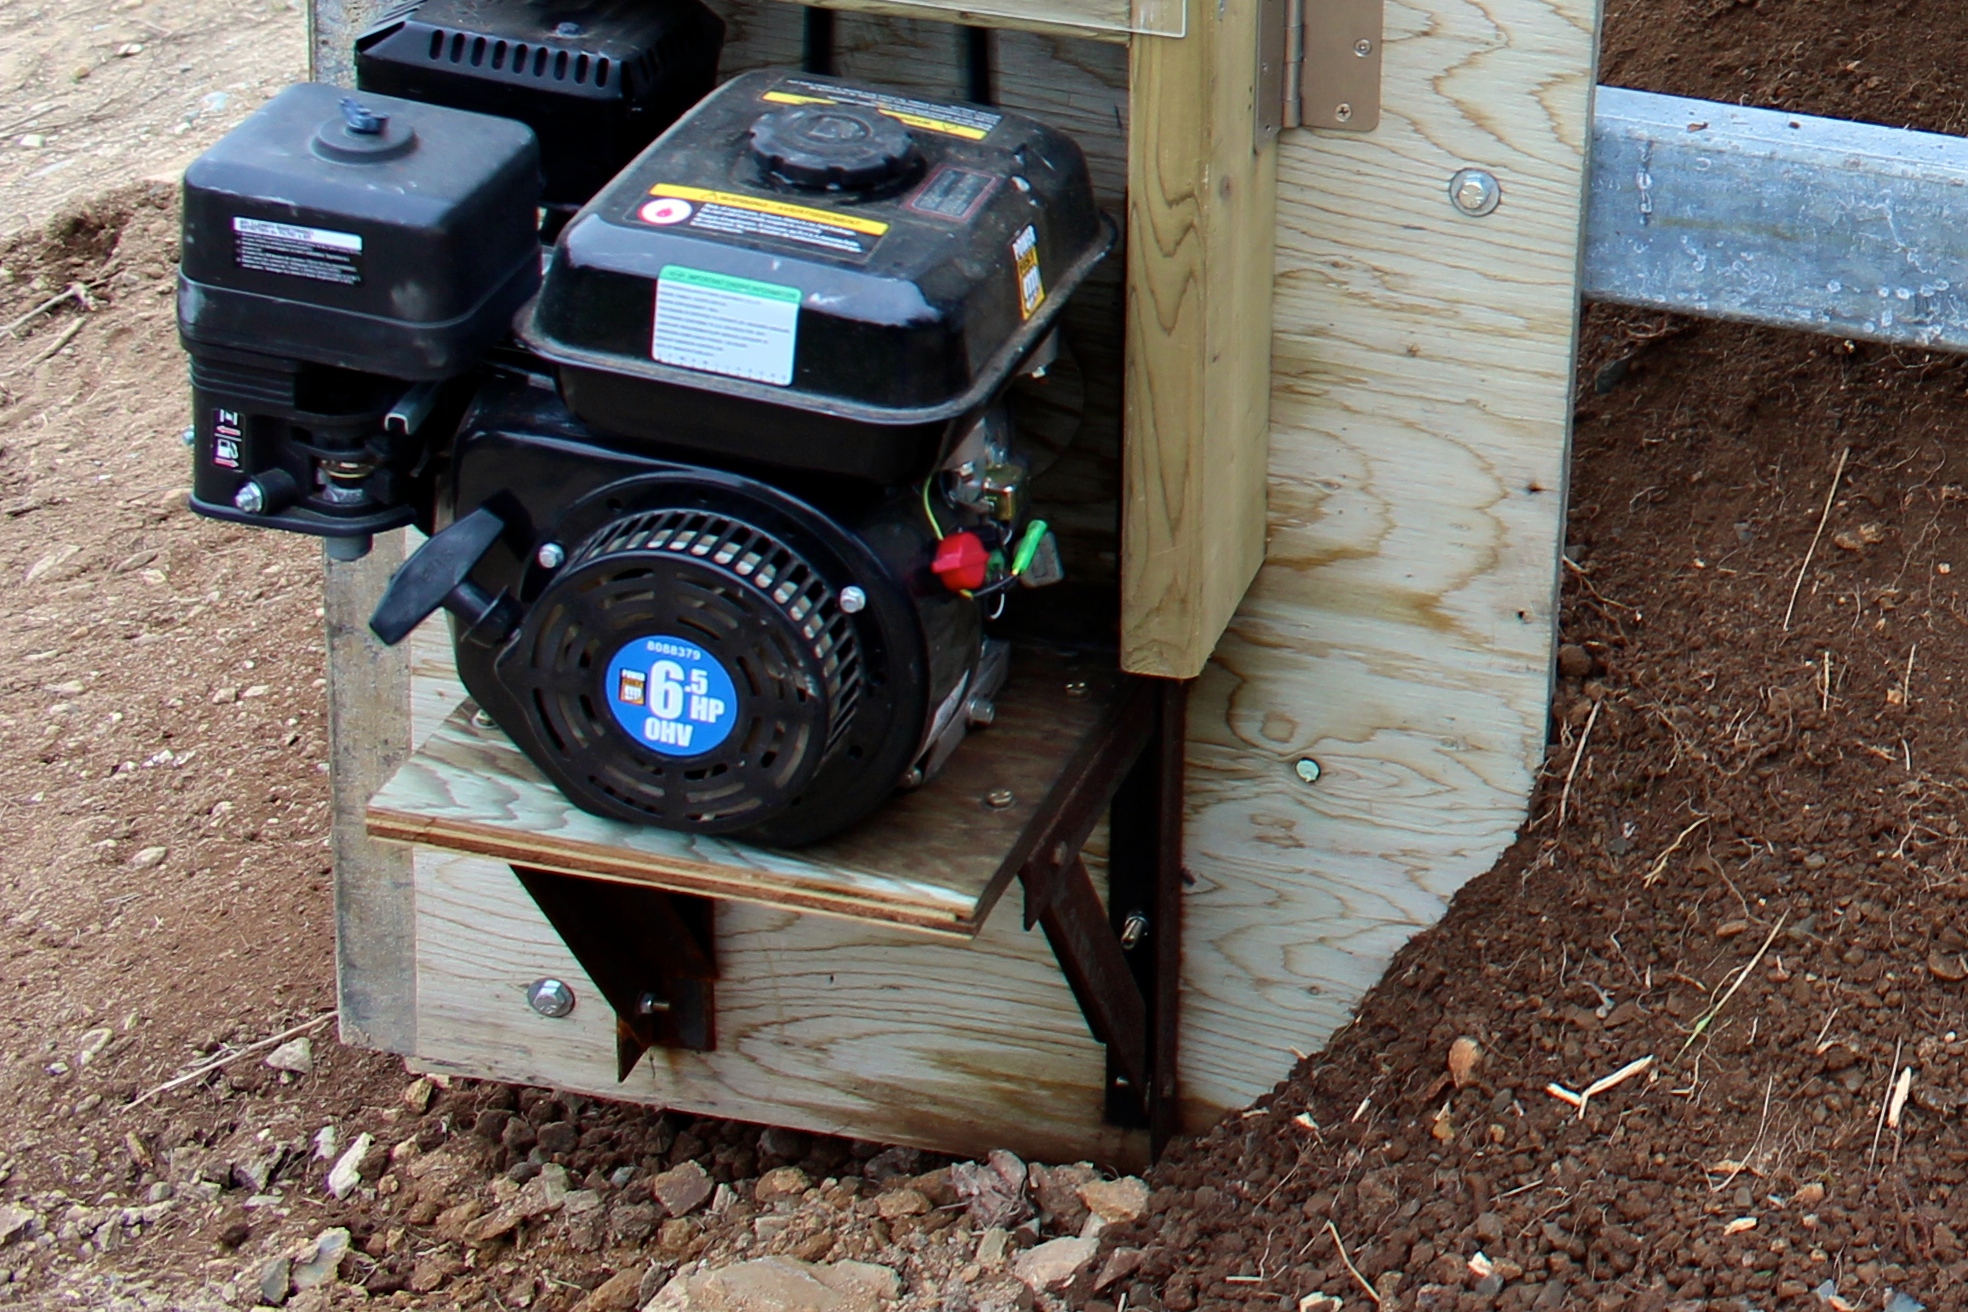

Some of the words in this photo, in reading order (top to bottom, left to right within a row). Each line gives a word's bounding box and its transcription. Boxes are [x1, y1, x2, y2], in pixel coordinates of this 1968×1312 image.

[646, 640, 702, 661] 8088379
[689, 695, 725, 724] HP
[644, 717, 693, 748] OHV
